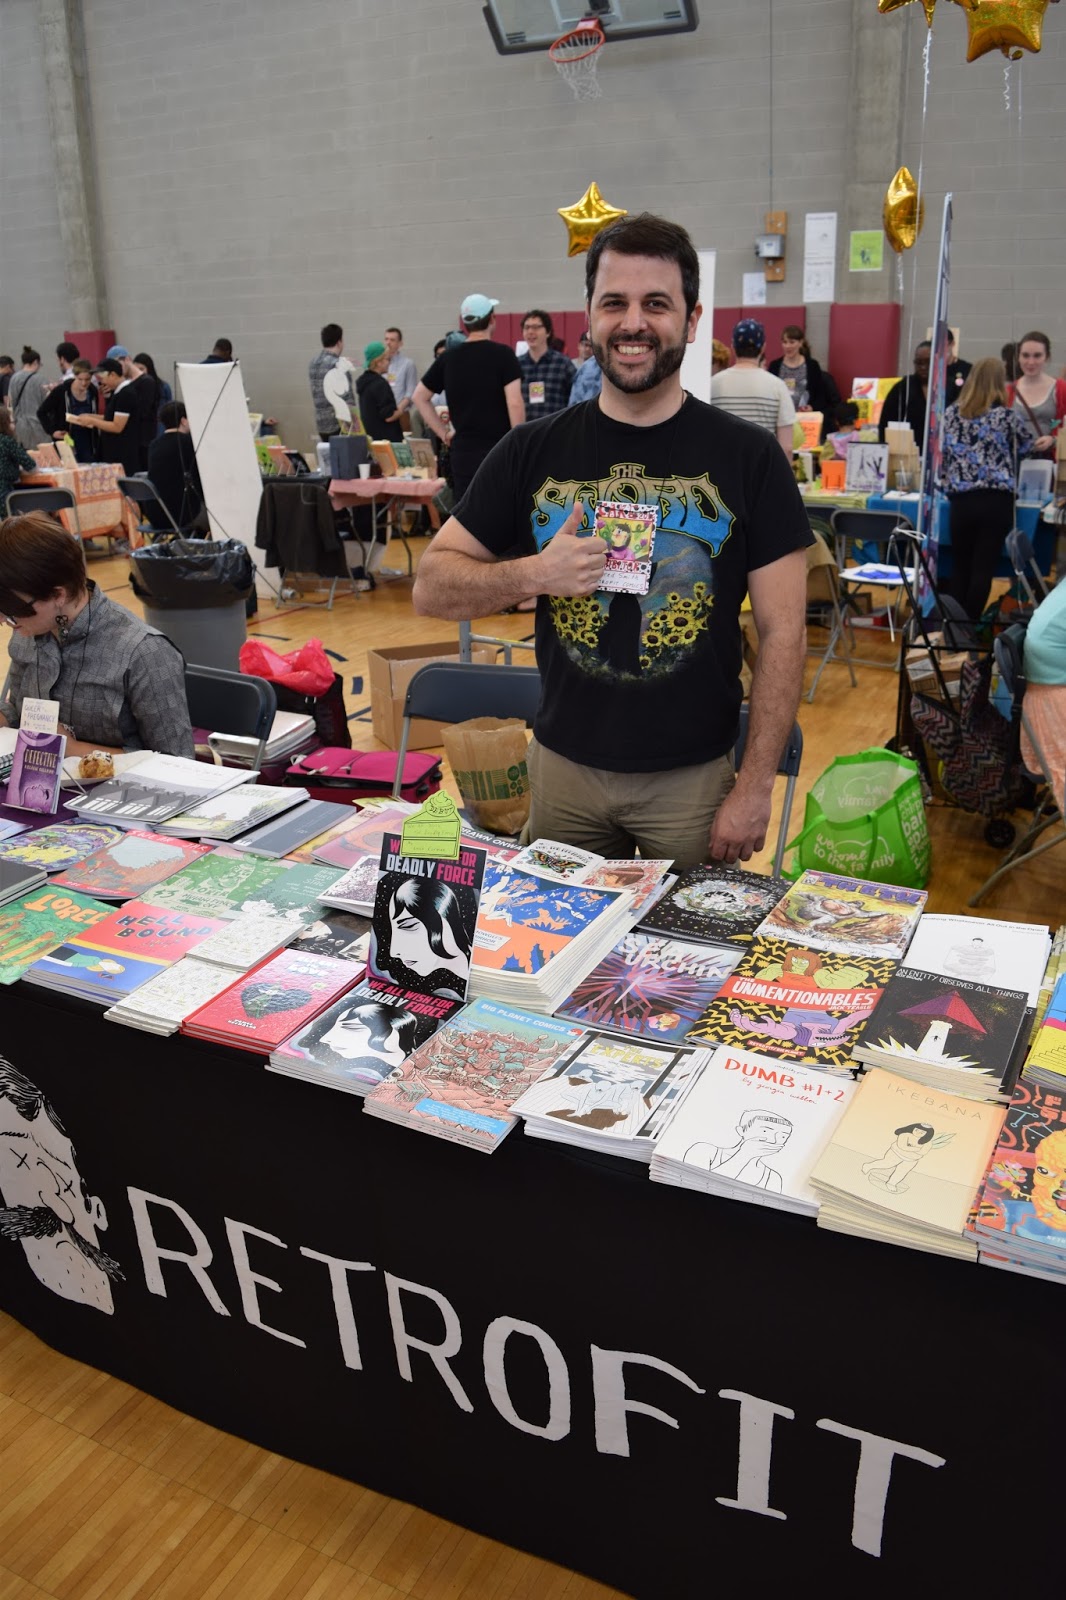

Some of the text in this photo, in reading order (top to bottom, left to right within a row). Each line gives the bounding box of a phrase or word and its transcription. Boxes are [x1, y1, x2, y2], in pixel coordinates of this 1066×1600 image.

[611, 465, 643, 478] THE
[386, 854, 477, 887] DEADLY FORCE
[814, 842, 826, 859] to
[827, 852, 847, 871] the
[115, 914, 185, 927] HELL
[115, 926, 214, 940] BOUND
[690, 914, 710, 924] ANNE
[711, 918, 737, 929] EMOND
[625, 950, 734, 979] URCHIN
[367, 980, 455, 1010] WE ALL WISH FOR
[731, 979, 878, 1007] UNMENTIONABLES
[896, 968, 1026, 1001] AN ENTITY OBSERVES ALL THINGS
[356, 987, 449, 1019] DEADLY FORCE
[480, 1003, 497, 1014] BIG
[497, 1007, 532, 1025] PLANET
[532, 1018, 567, 1032] COMICS
[591, 1042, 666, 1069] EXPERTS
[723, 1057, 796, 1089] DUMB
[886, 1082, 984, 1121] IKEBANA
[127, 1186, 946, 1558] RETROFIT
